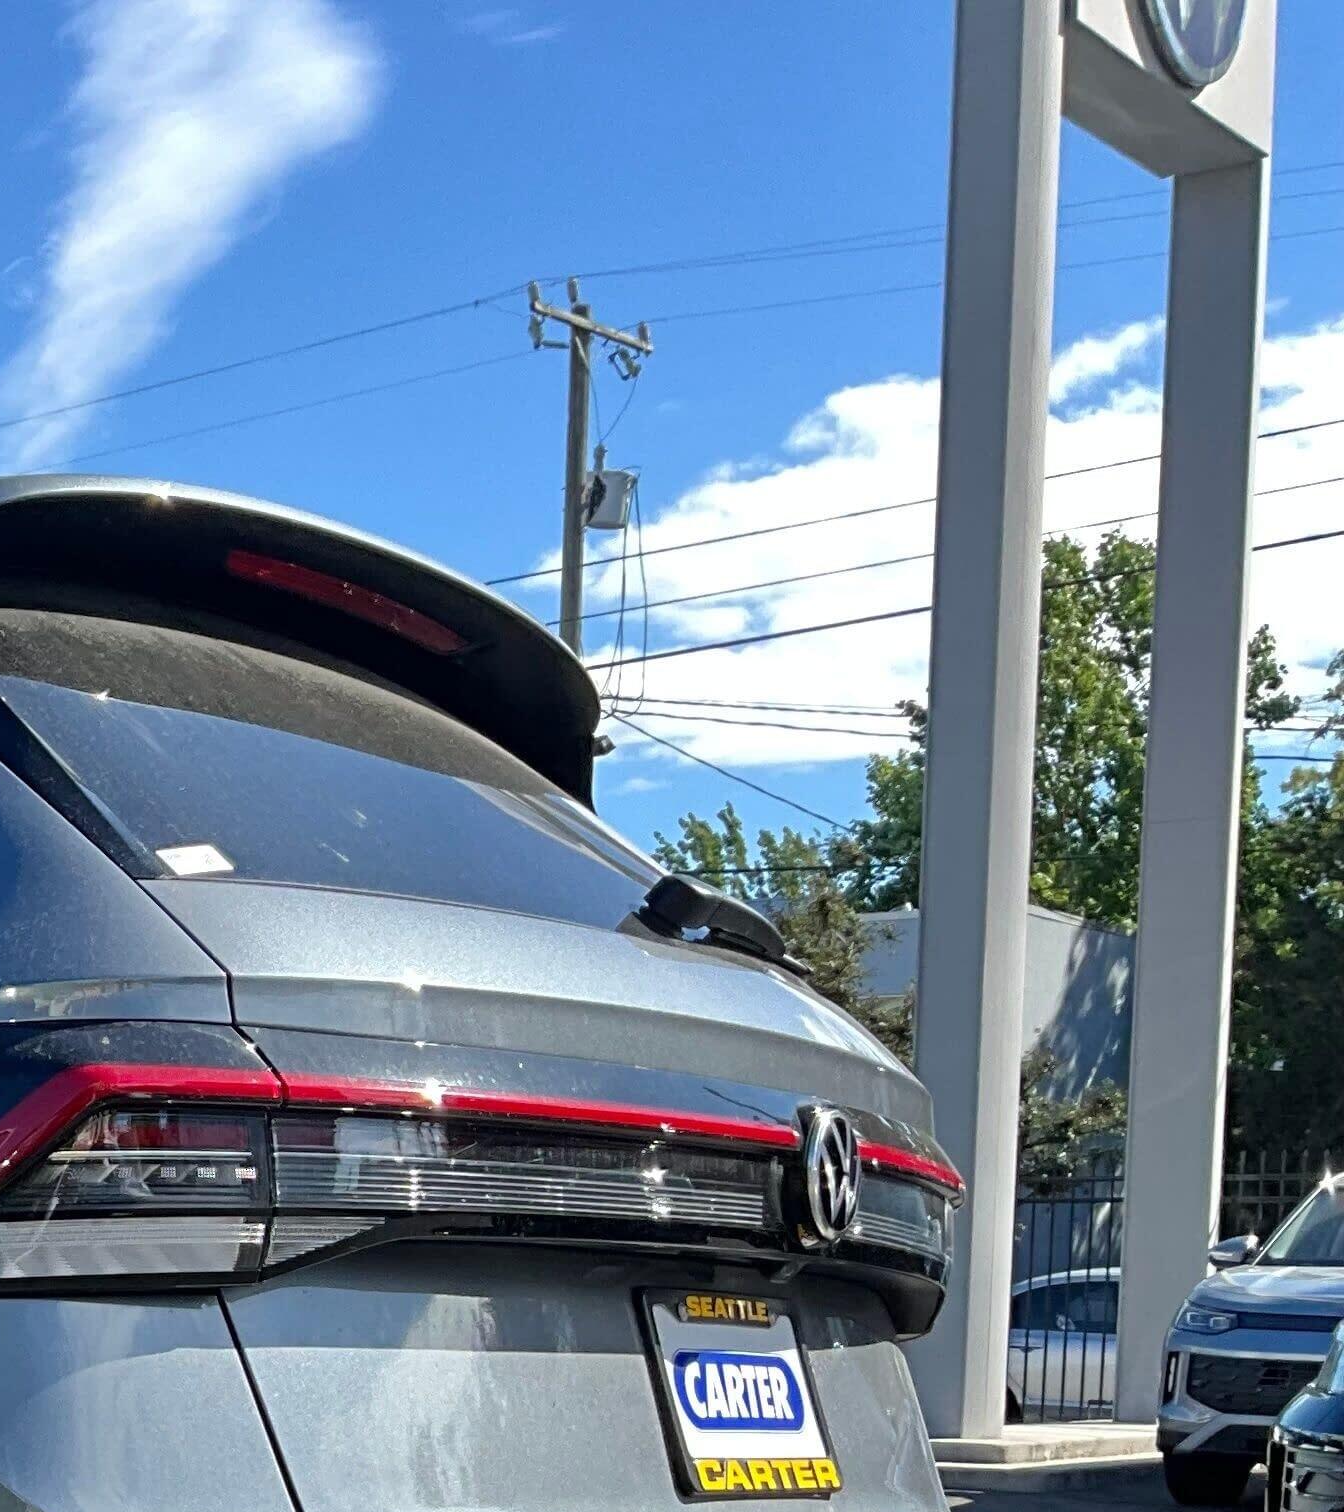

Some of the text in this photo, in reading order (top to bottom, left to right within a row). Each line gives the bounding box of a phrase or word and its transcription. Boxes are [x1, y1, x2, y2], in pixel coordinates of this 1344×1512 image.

[684, 1295, 769, 1322] SEATTLE
[683, 1360, 796, 1420] CARTER
[694, 1458, 842, 1491] CARTER
